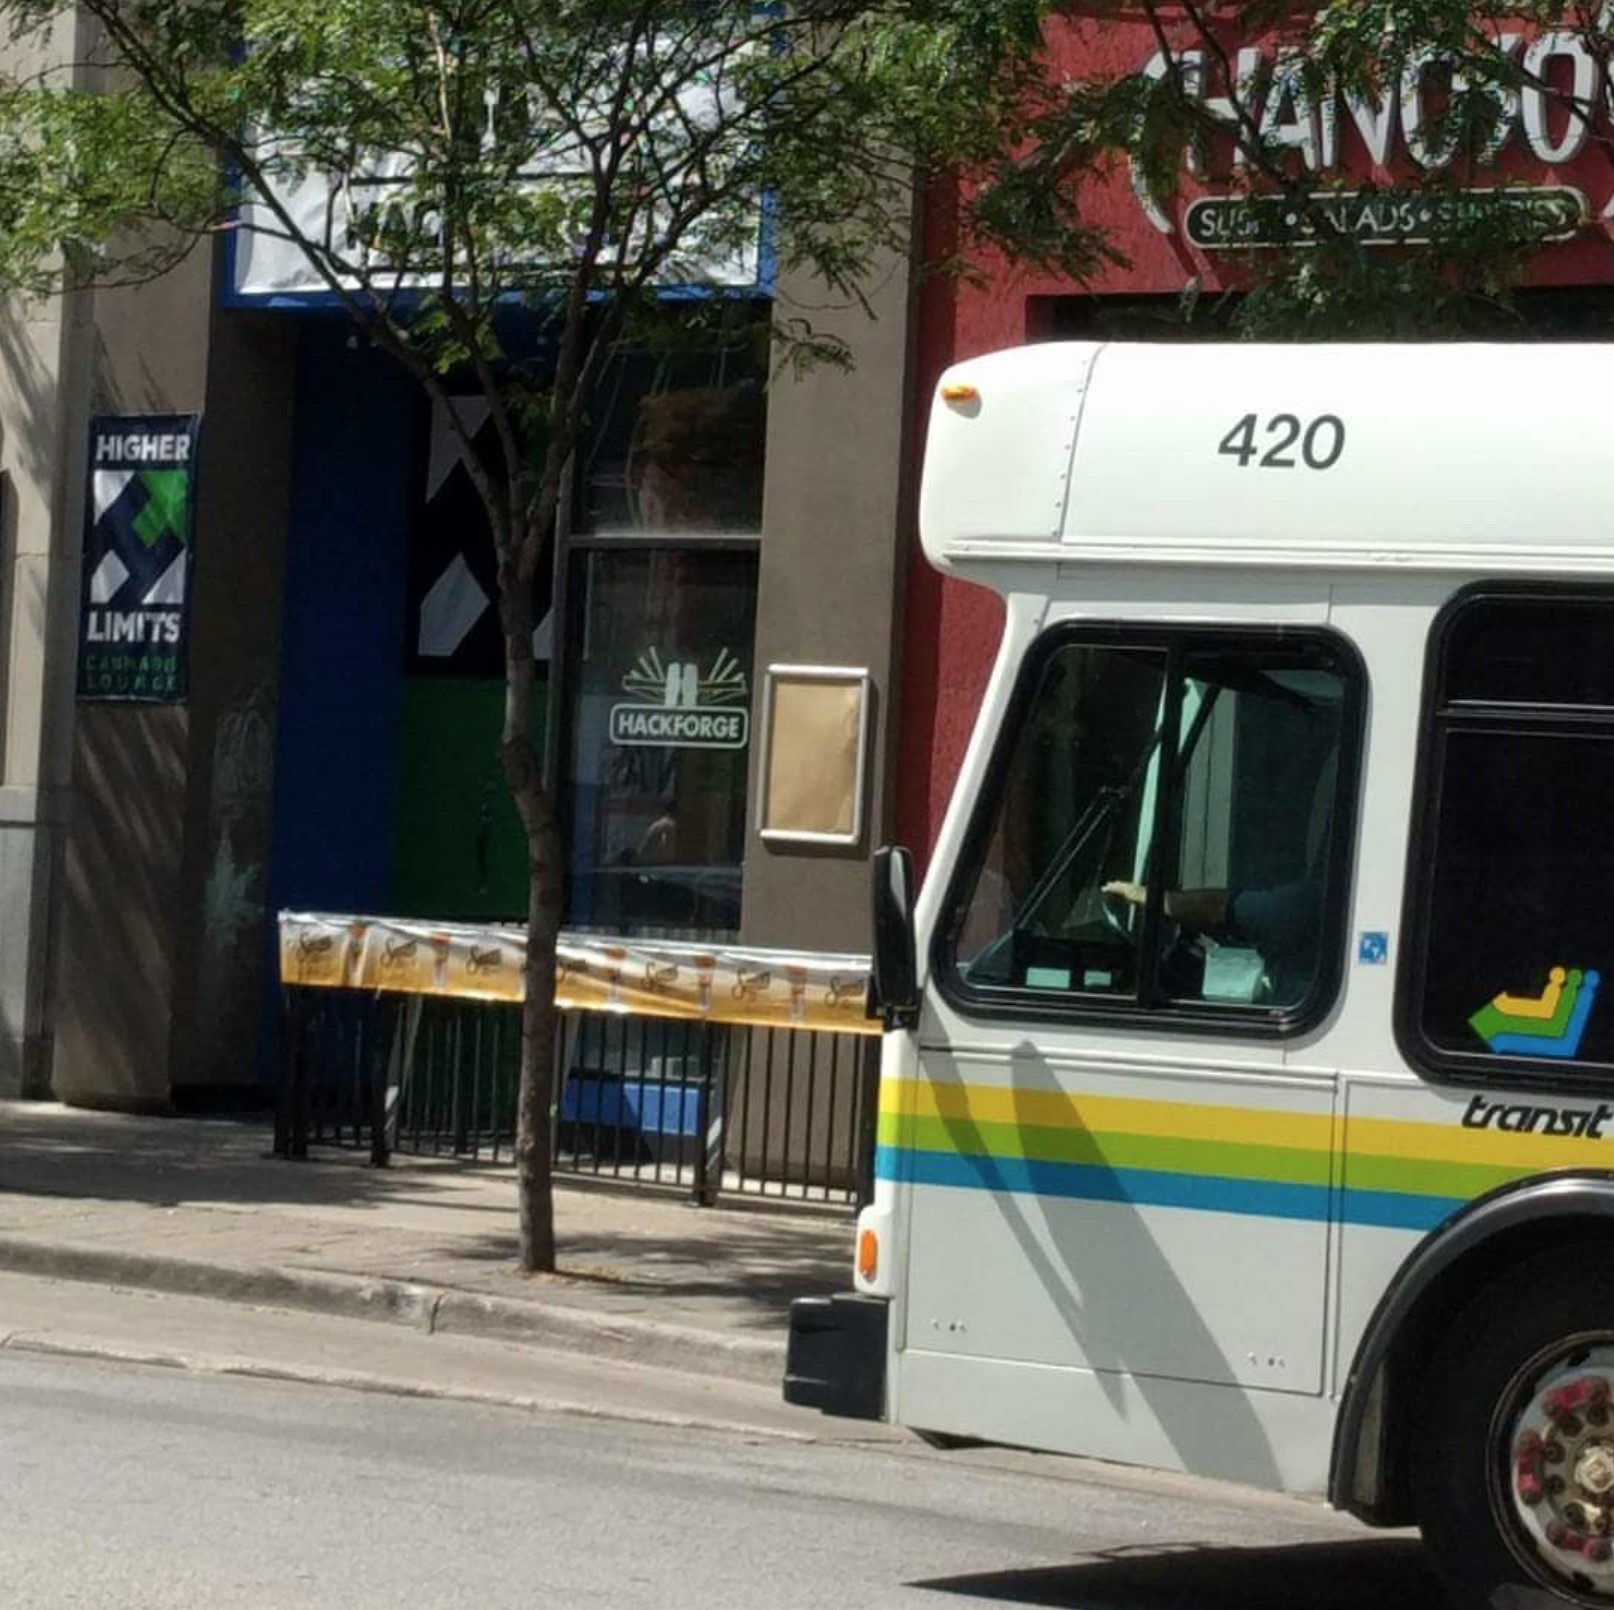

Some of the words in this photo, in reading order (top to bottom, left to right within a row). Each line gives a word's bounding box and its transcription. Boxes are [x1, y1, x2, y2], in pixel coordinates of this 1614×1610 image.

[95, 433, 191, 462] HIGHER
[1217, 413, 1346, 470] 420
[87, 611, 181, 644] LIMITS
[617, 712, 740, 739] HACKFORGE
[1461, 1094, 1614, 1140] transit
